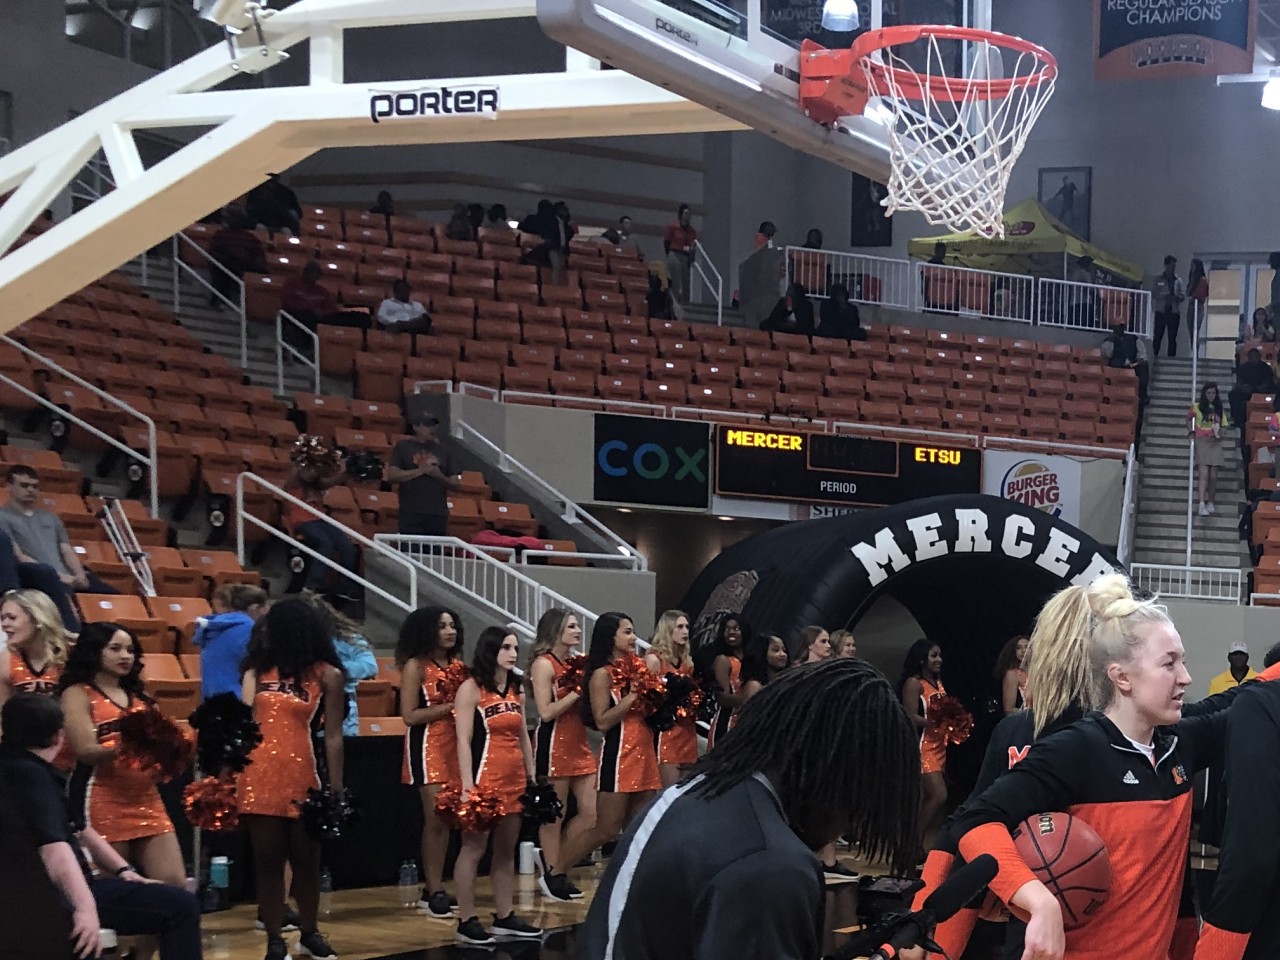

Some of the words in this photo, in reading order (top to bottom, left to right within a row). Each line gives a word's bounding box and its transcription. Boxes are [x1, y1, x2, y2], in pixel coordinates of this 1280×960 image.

[1126, 5, 1222, 25] CHAMPIONS
[370, 87, 498, 123] porter
[727, 430, 803, 451] MERCER
[598, 439, 706, 483] COX
[915, 447, 961, 465] ETSU
[820, 480, 857, 494] PERIOD
[1007, 473, 1058, 496] BURGER
